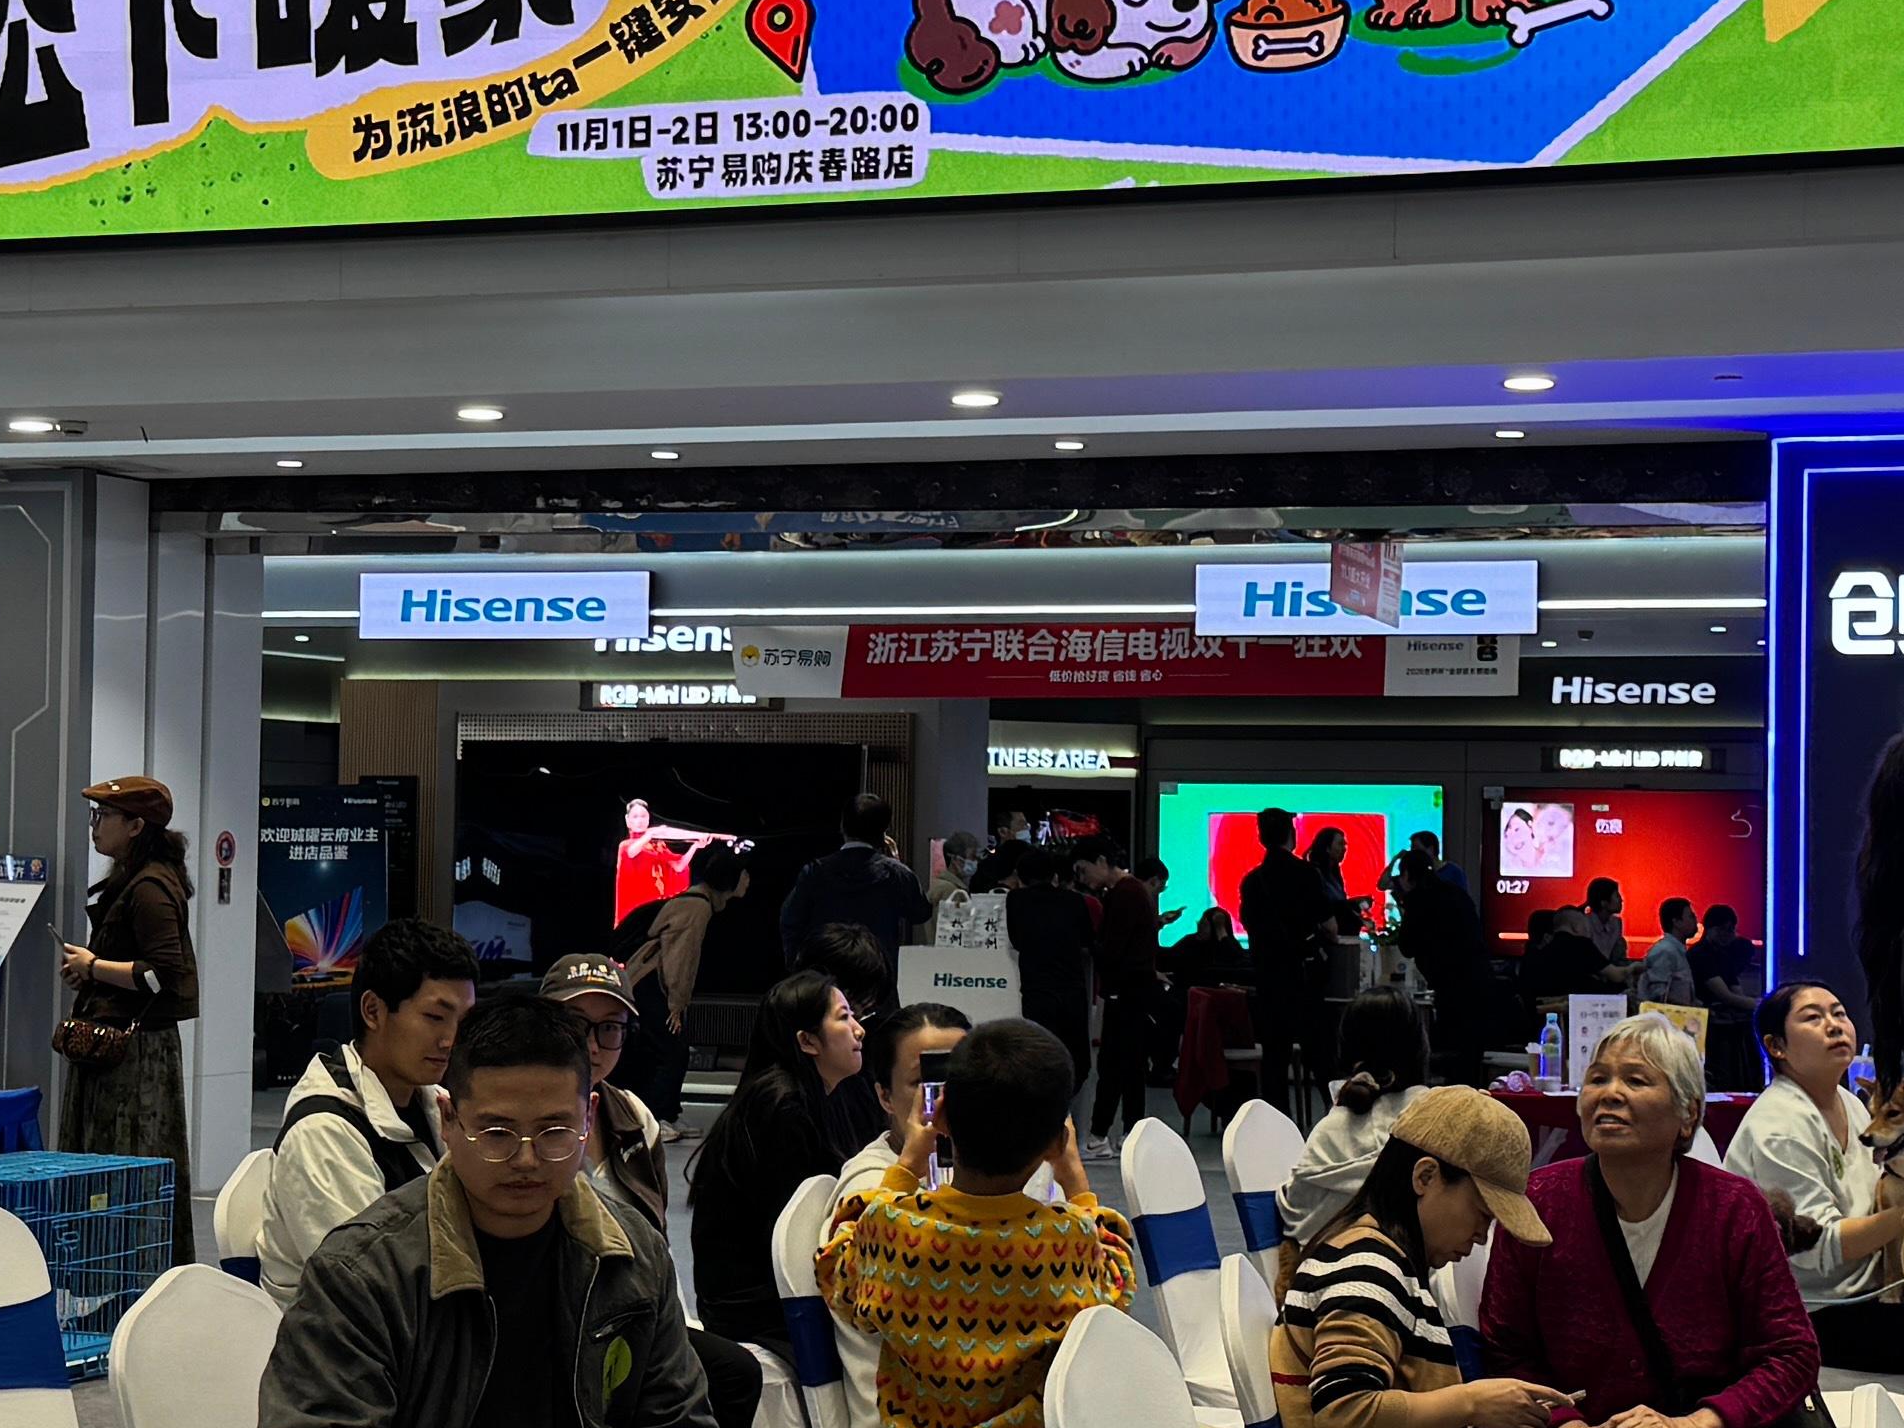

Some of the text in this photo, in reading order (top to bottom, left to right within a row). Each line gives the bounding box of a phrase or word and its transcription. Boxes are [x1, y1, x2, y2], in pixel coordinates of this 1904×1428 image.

[556, 103, 921, 153] 11月1日-2日 13:00-20:00
[655, 144, 915, 192] 苏宁易购庆春路店
[399, 587, 607, 623] Hisense
[1243, 581, 1487, 618] Hisse
[1407, 640, 1464, 651] Hisense
[763, 647, 832, 668] 苏宁易购
[1551, 676, 1717, 705] Hisense
[1055, 748, 1111, 771] AREA
[289, 845, 349, 861] 进店品鉴
[1497, 880, 1530, 894] 01:27
[933, 972, 1008, 989] Hisense
